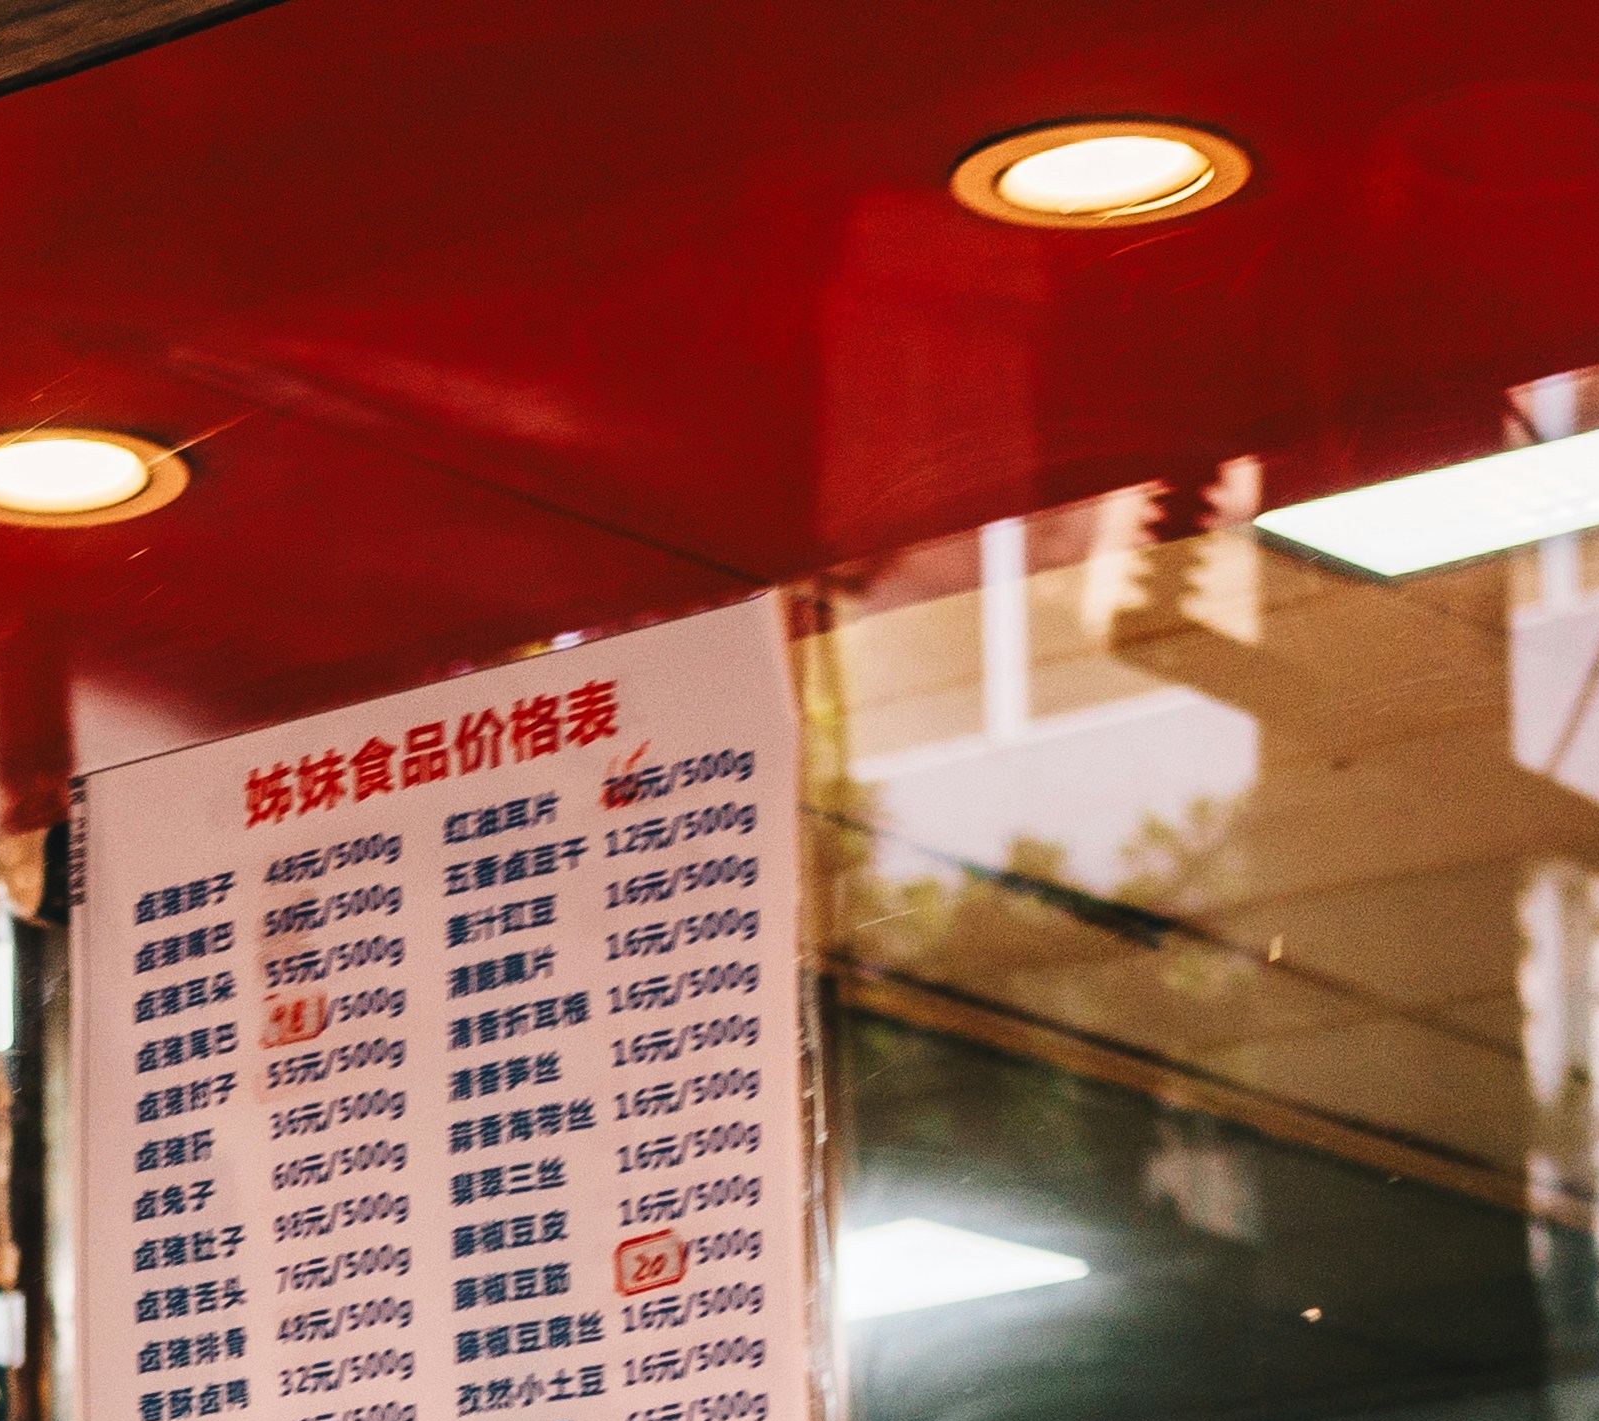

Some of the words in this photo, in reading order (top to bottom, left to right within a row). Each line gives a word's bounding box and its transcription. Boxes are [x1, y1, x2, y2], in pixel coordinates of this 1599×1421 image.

[244, 679, 620, 829] 姊妹食品价格表
